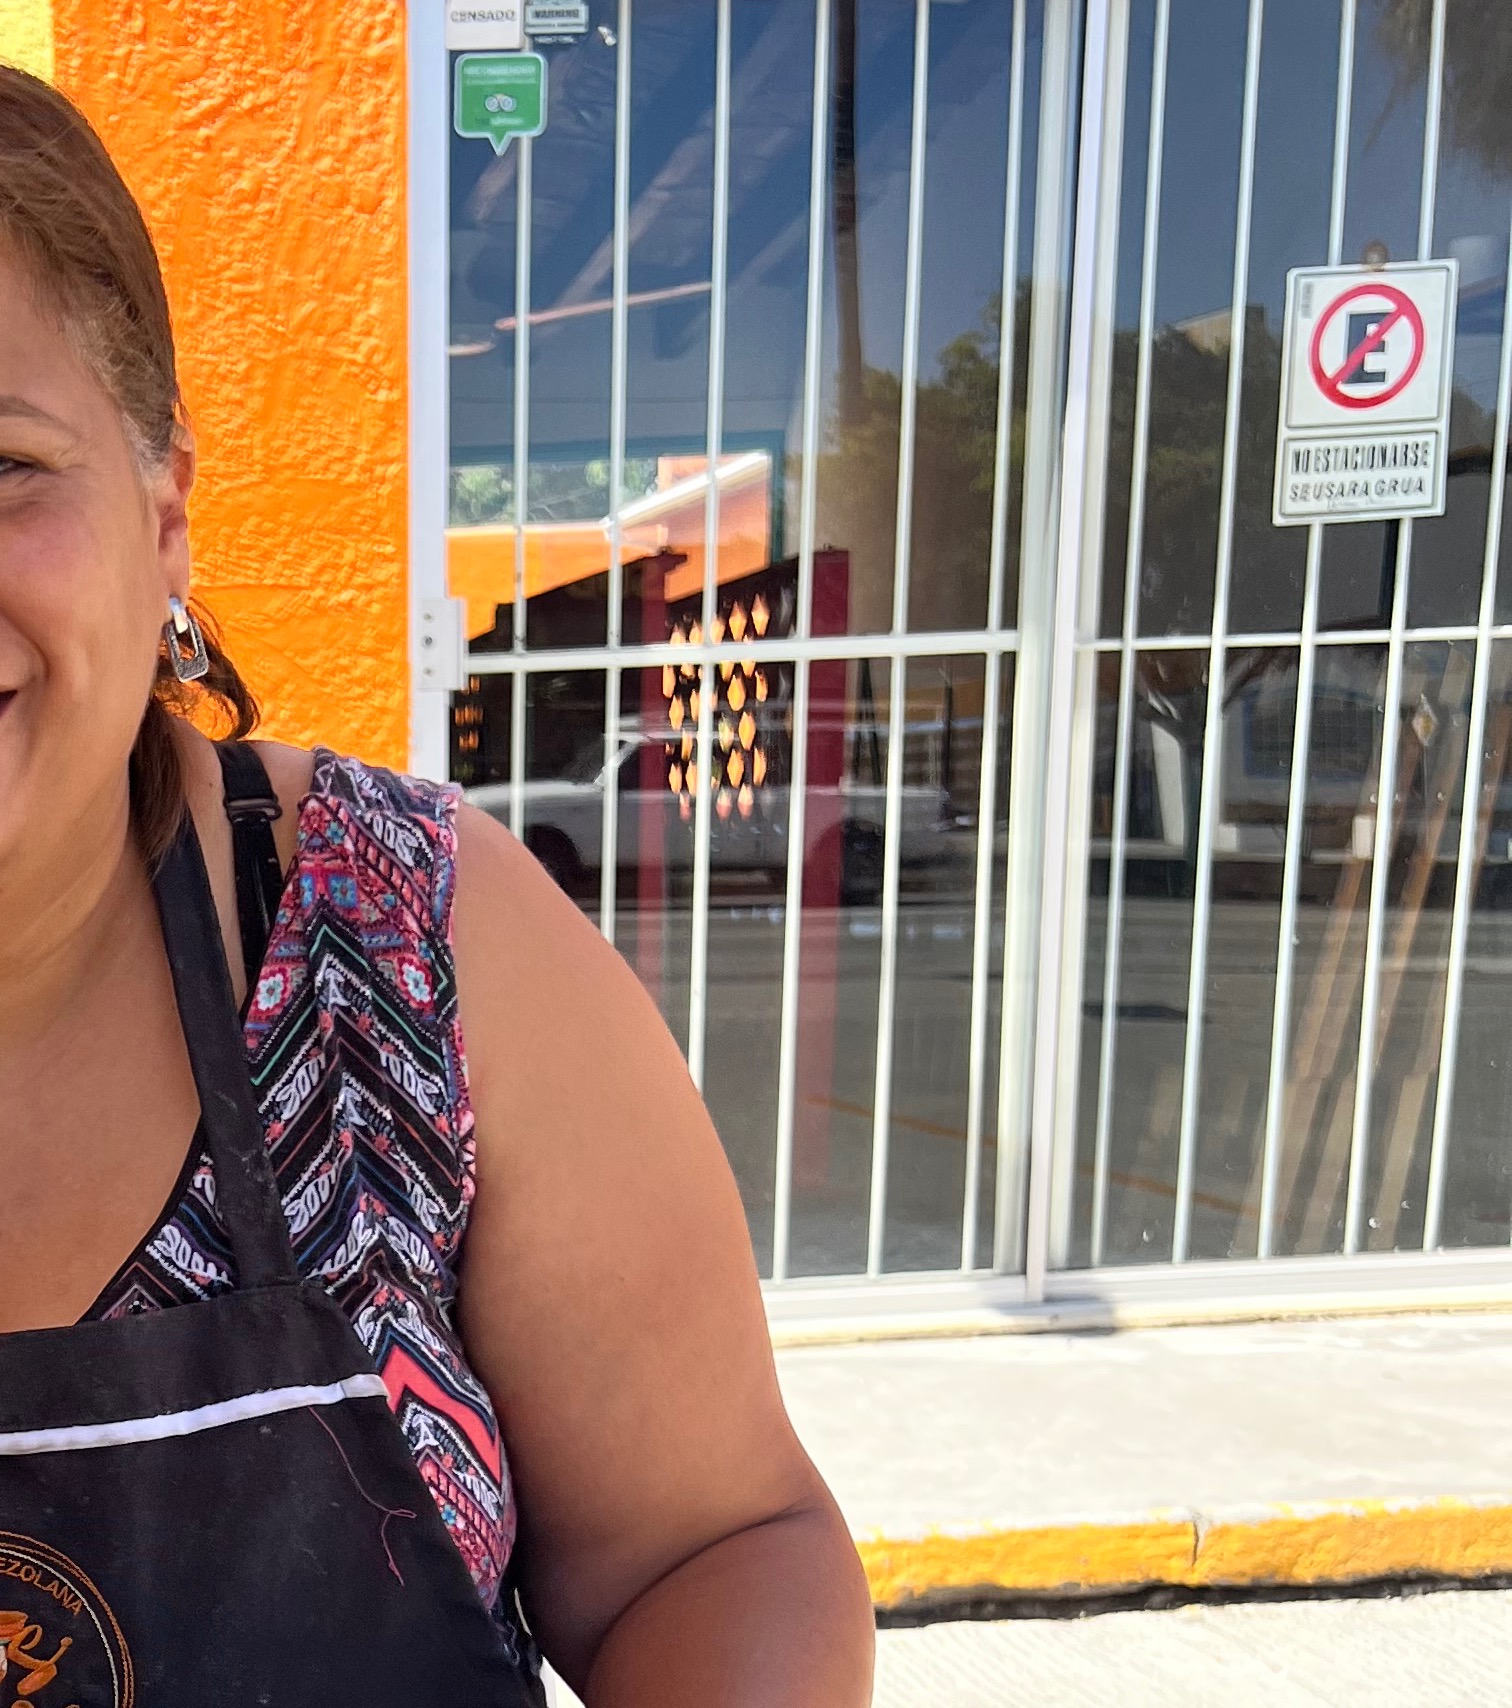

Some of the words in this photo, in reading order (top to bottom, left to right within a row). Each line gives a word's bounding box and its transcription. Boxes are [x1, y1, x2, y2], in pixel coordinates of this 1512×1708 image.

[450, 10, 515, 23] CENSADO
[1345, 312, 1394, 384] E
[1291, 447, 1311, 474] NO
[1314, 440, 1431, 473] ESTACIONARSE
[1289, 481, 1311, 501] SE
[1374, 475, 1425, 496] GRUA
